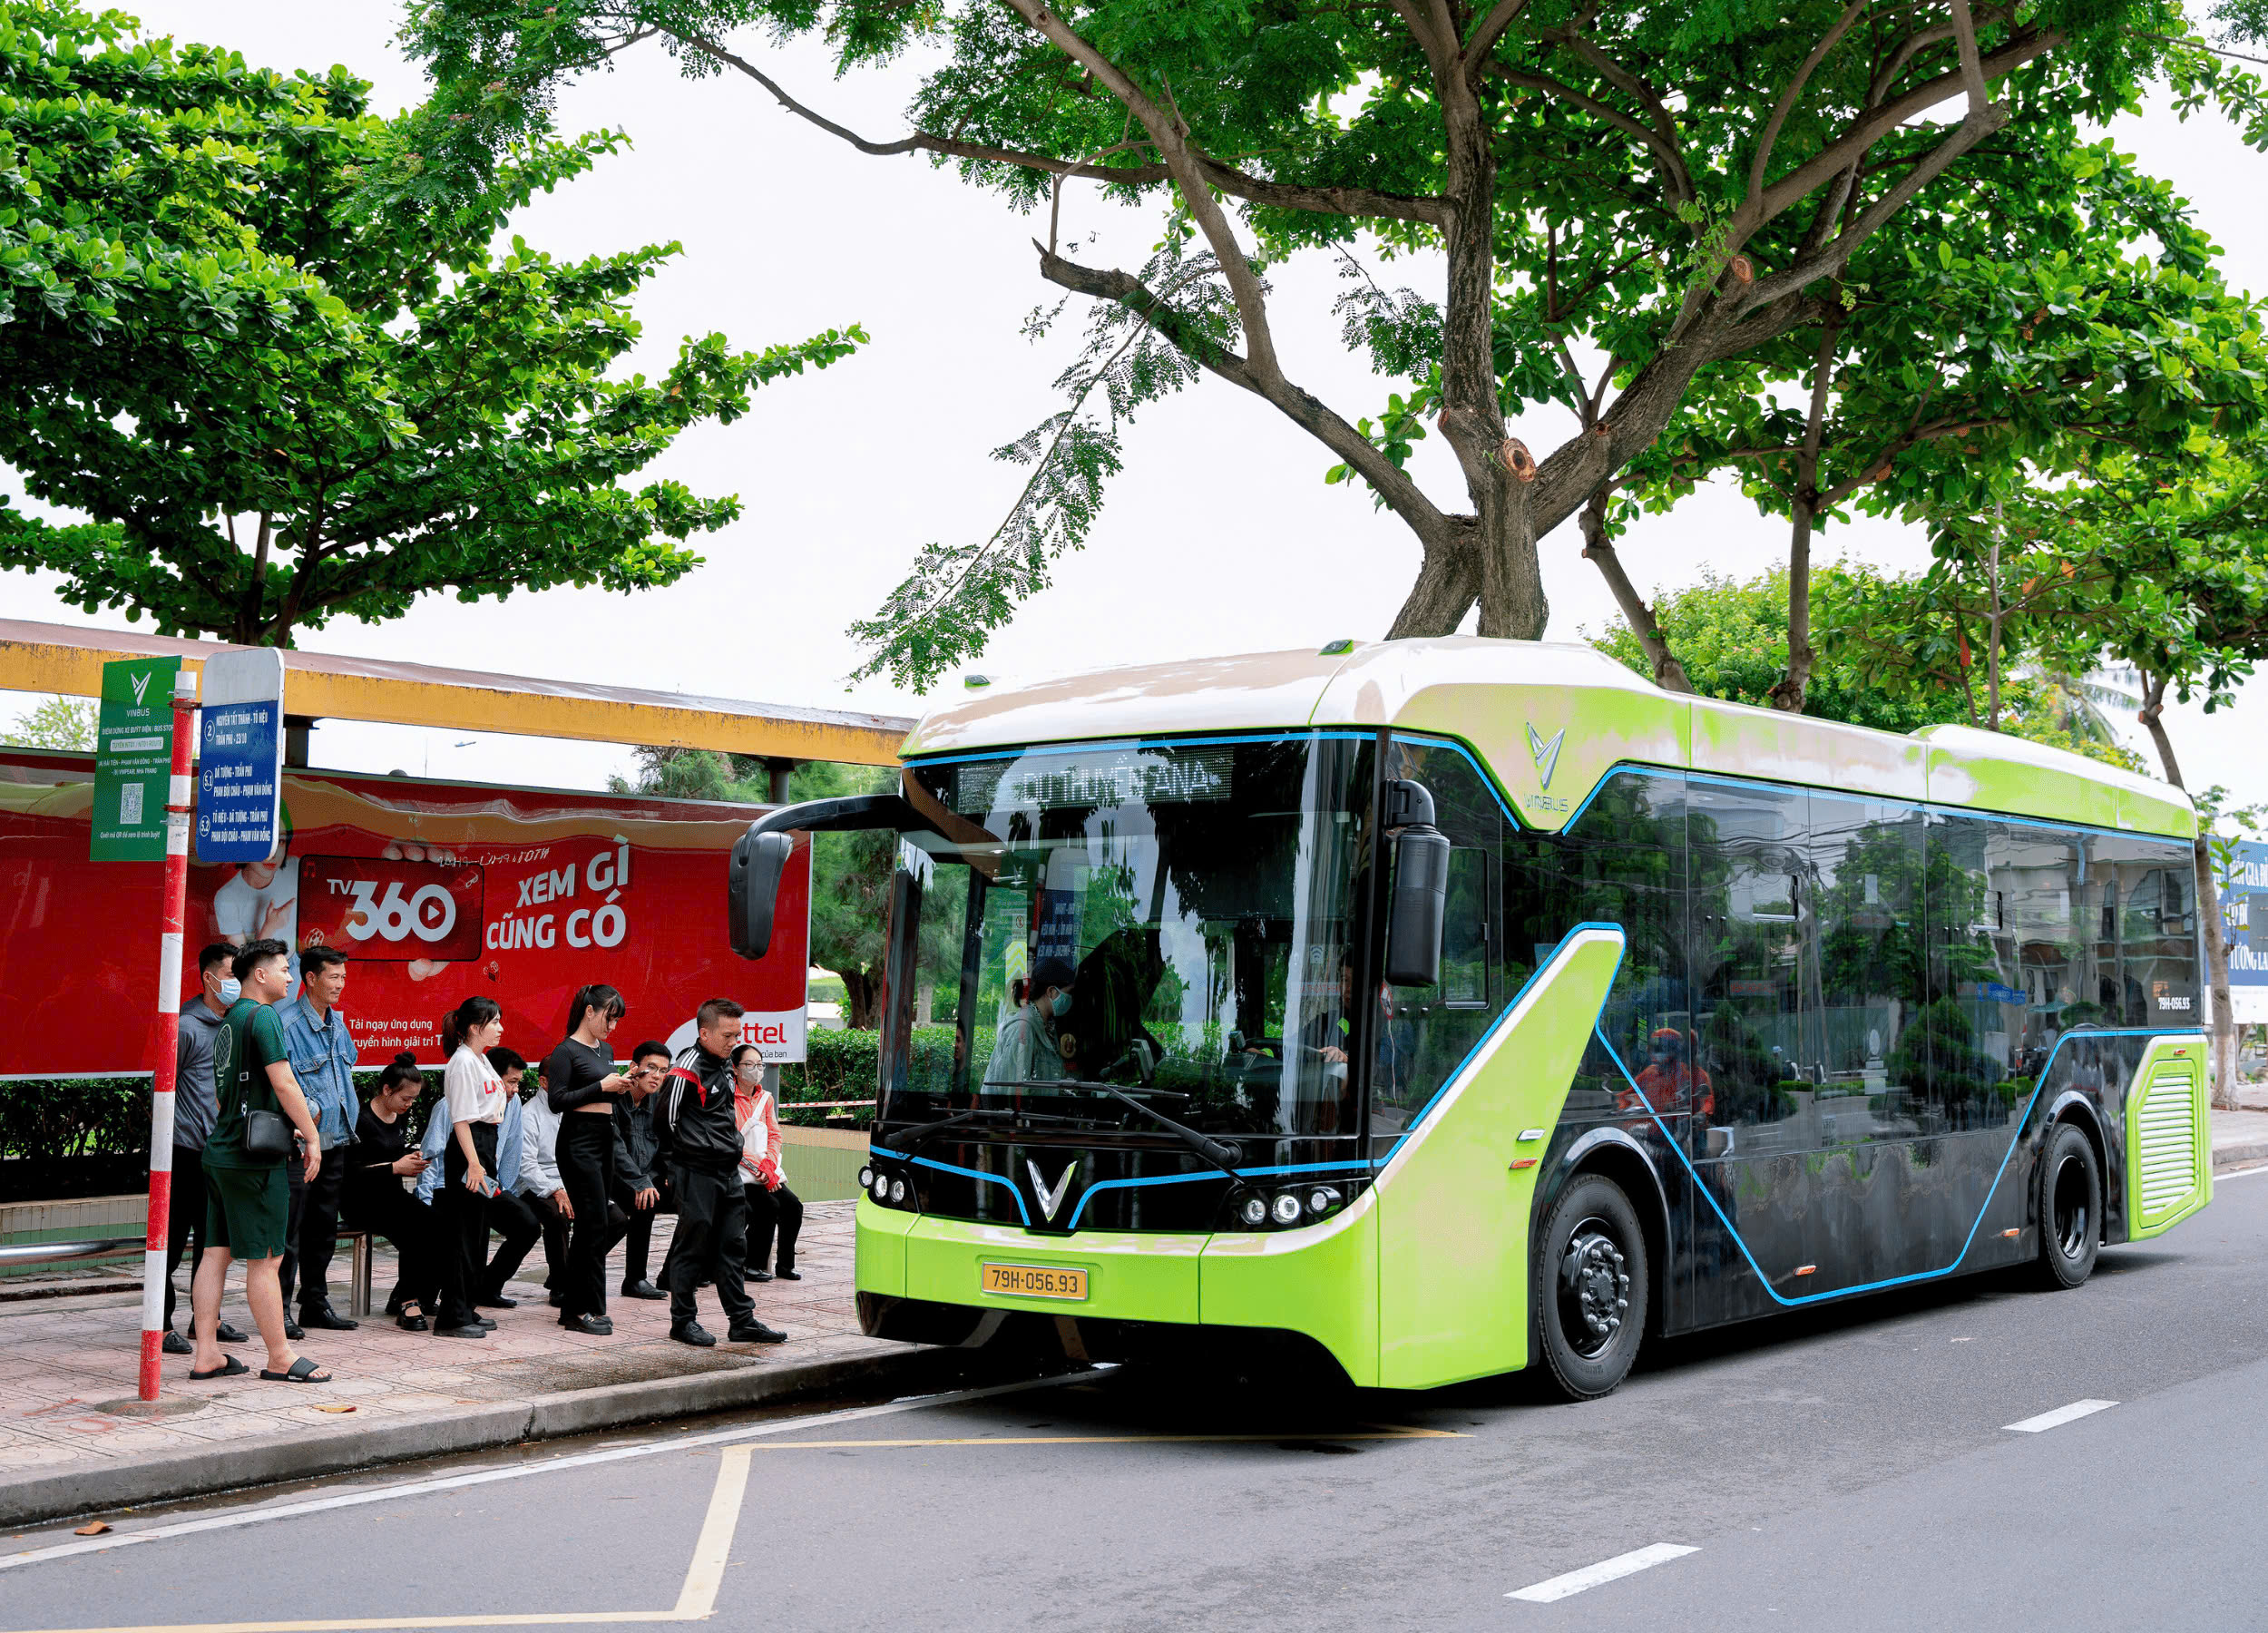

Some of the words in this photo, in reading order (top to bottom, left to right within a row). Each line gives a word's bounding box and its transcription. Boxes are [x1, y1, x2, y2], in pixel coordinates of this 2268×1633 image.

[127, 709, 150, 718] VINBUS
[207, 725, 212, 737] 2
[1524, 793, 1569, 813] VINBUS
[515, 863, 576, 908] XEM
[586, 833, 630, 892] GÌ
[486, 912, 556, 950] CŨNG
[565, 889, 627, 949] CÓ
[349, 1019, 364, 1030] Tải
[366, 1021, 388, 1032] ngay
[390, 1019, 408, 1031] ứng
[409, 1019, 433, 1031] dụng
[737, 1022, 787, 1044] ttel
[353, 1035, 379, 1050] ruyền
[381, 1036, 402, 1047] hình
[404, 1036, 420, 1049] giải
[423, 1036, 434, 1046] trí
